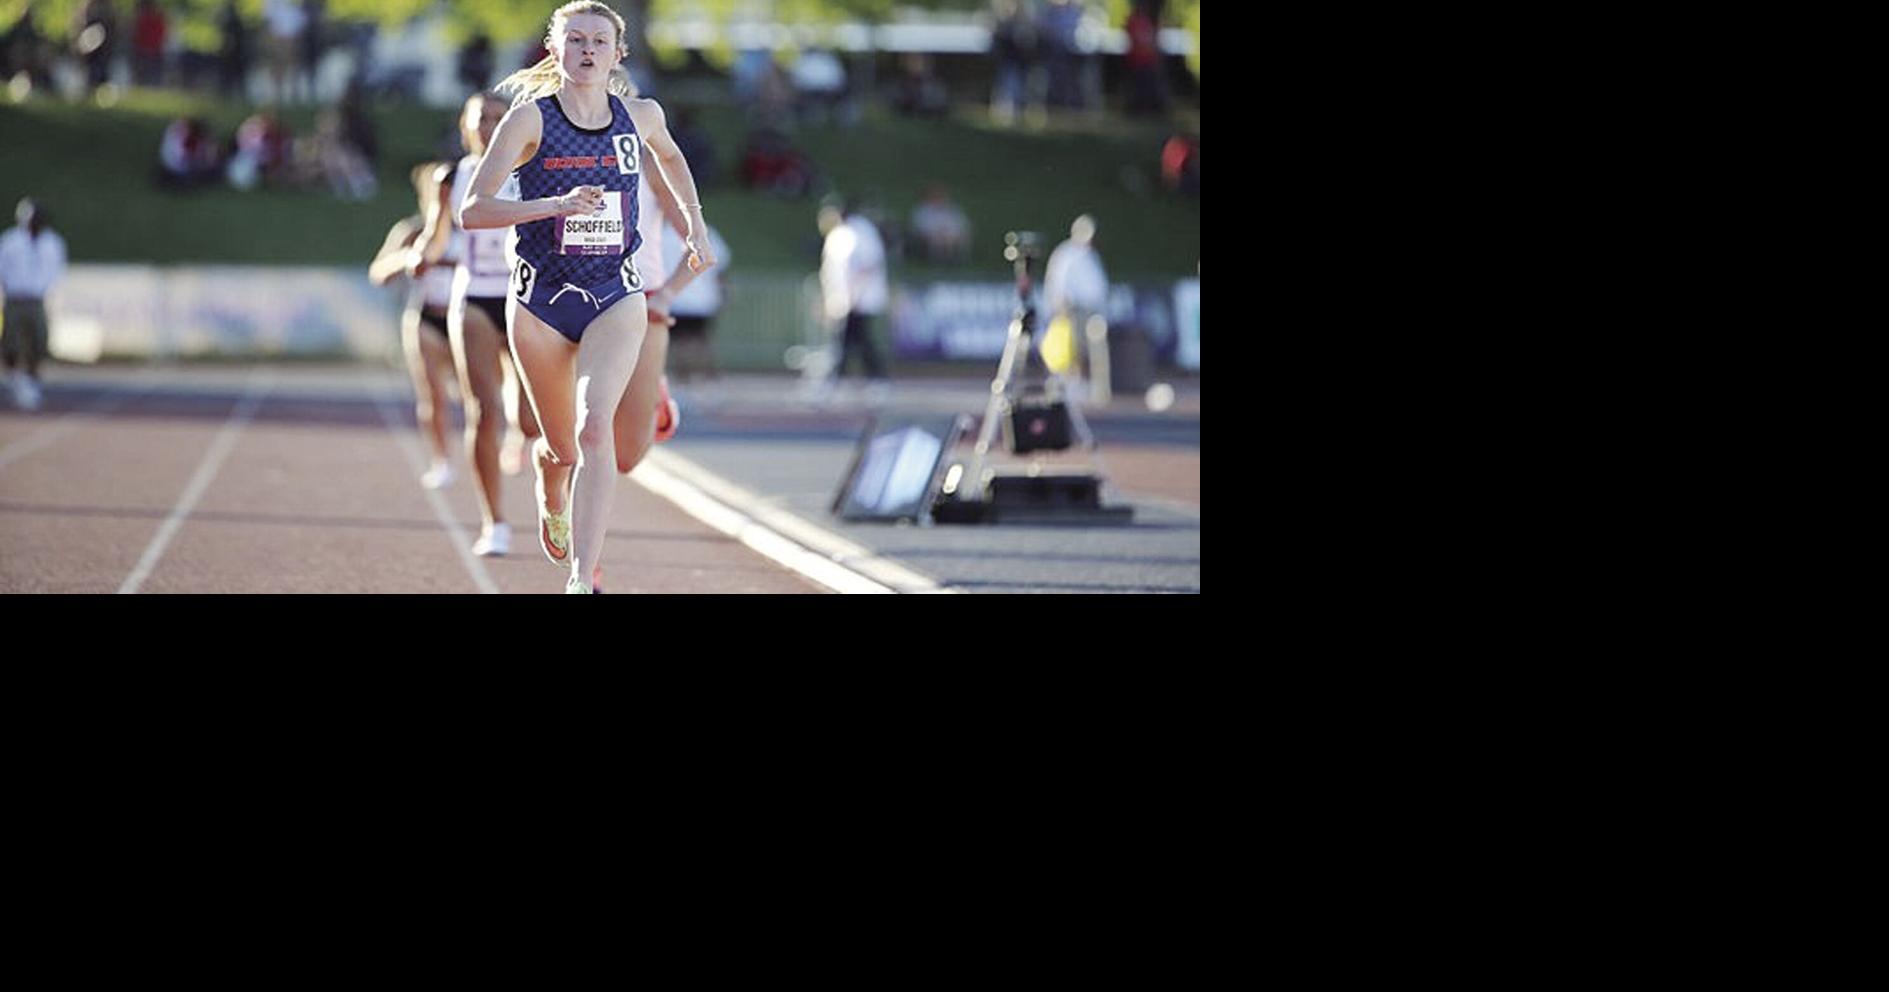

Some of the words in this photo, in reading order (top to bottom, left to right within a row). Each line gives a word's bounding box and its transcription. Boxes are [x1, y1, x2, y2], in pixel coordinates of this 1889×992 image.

[619, 136, 637, 171] 8
[565, 219, 621, 233] SCHOFFIELD
[624, 256, 640, 288] 8
